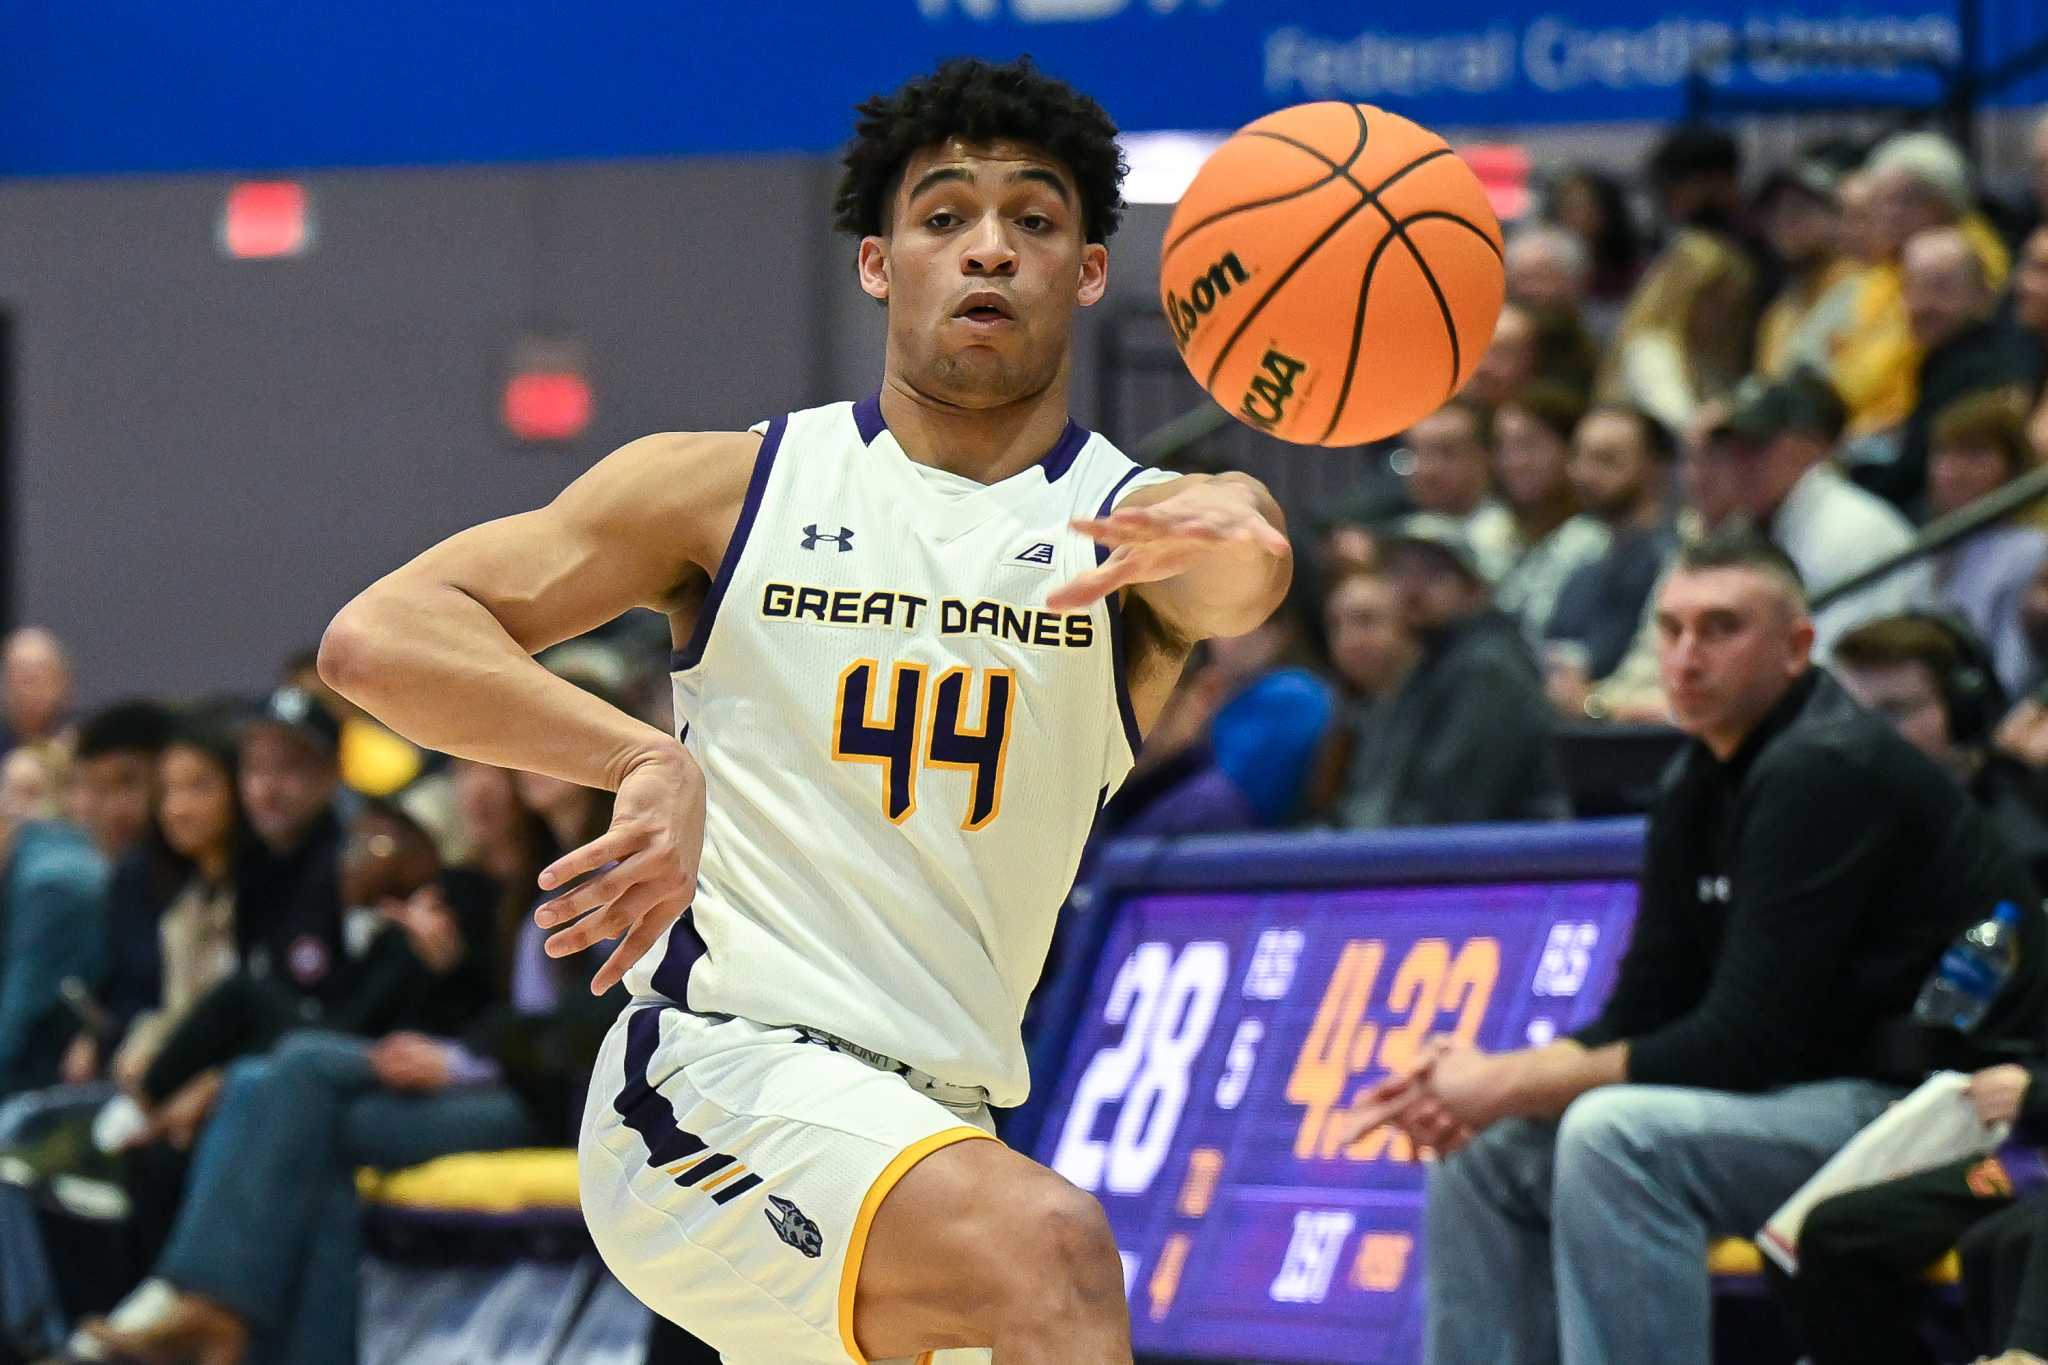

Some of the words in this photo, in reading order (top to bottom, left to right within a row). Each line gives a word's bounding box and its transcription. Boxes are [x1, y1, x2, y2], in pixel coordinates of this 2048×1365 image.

[1240, 349, 1306, 430] CAA
[761, 582, 928, 630] GREAT
[940, 598, 1094, 648] DANES
[831, 657, 1017, 832] 44
[1052, 940, 1230, 1195] 28
